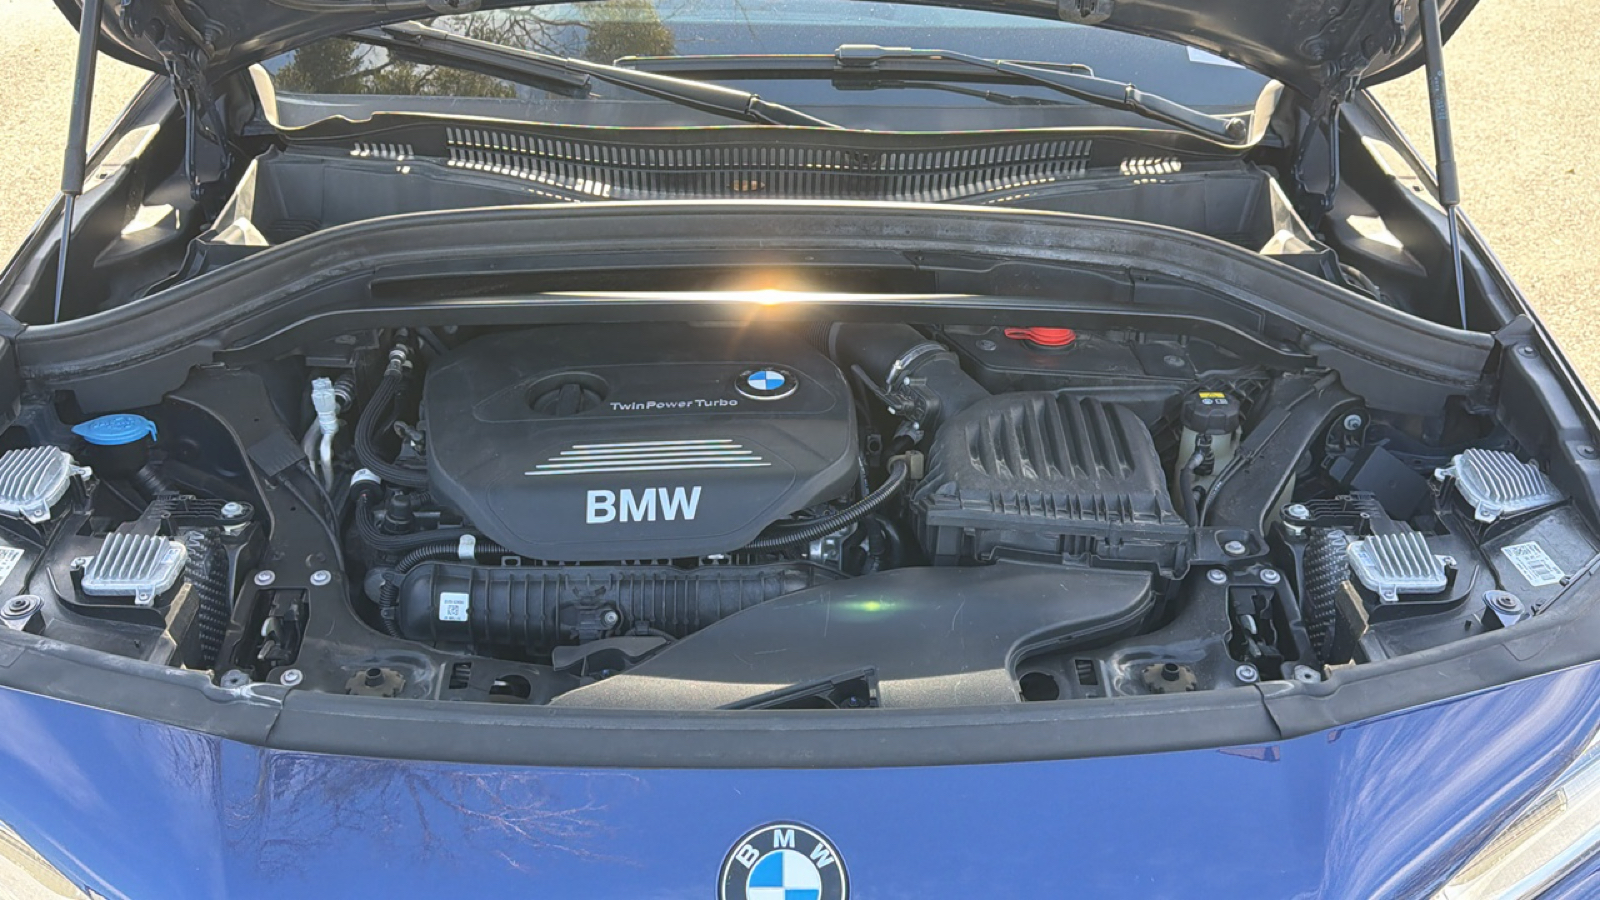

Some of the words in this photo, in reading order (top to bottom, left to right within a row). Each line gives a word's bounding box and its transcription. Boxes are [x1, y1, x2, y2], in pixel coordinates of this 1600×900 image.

[694, 399, 738, 407] Turbo
[586, 486, 702, 524] BMW
[735, 829, 835, 869] BMW
